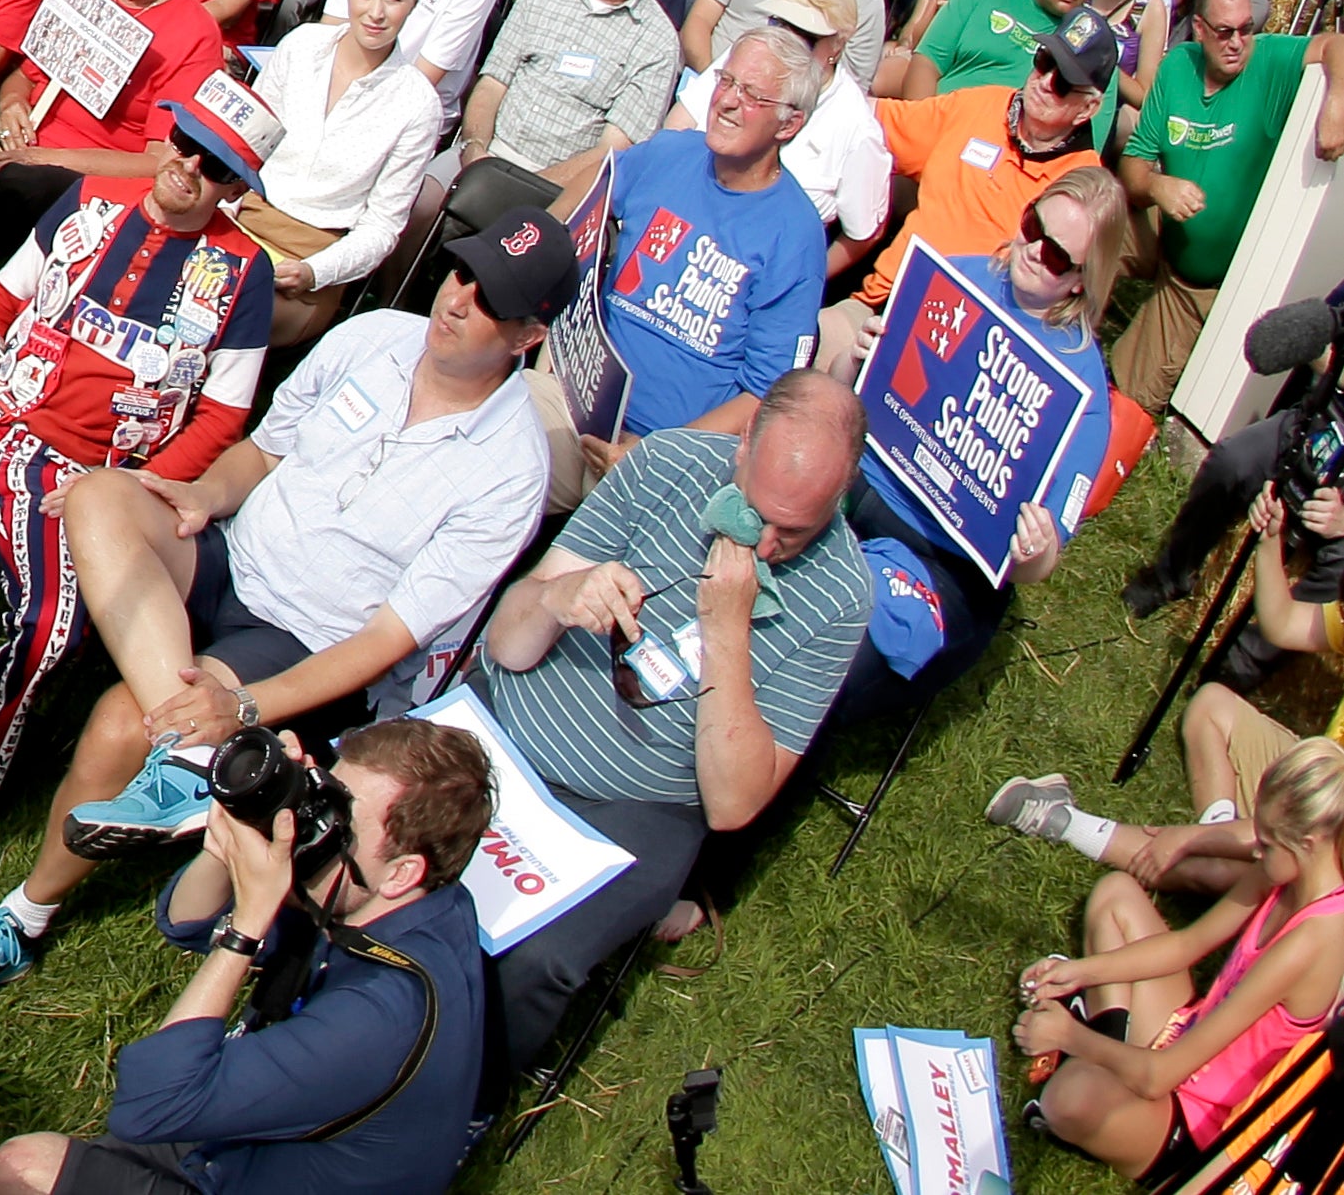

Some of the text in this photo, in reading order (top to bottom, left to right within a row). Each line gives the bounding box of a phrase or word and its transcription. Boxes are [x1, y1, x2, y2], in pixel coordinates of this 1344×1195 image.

[78, 21, 133, 67] SOCIAL SECURITY
[198, 76, 255, 128] VOTE
[60, 216, 84, 260] VOTE
[500, 222, 540, 255] B
[687, 235, 749, 295] Strong
[161, 281, 185, 323] VOTE
[579, 267, 608, 367] Strong
[646, 284, 723, 348] Schools
[674, 266, 732, 319] Public
[560, 303, 594, 413] Schools
[571, 298, 600, 391] Public
[663, 323, 679, 338] ALL
[678, 331, 716, 358] STUDENTS
[979, 323, 1053, 428] Strong
[115, 403, 151, 417] CAUCUS
[339, 391, 366, 420] O'MALLEY
[964, 371, 1030, 460] Public
[883, 392, 999, 516] GIVE OPPORTUNITY TO ALL STUDENTS
[935, 396, 1013, 499] Schools
[890, 445, 964, 529] strongpublicschools.org
[13, 497, 30, 543] VOTE
[638, 648, 672, 684] O'MALLEY
[500, 826, 561, 885] REBUILD THE
[367, 945, 410, 966] Nikon
[927, 1059, 965, 1195] 'MALLEY
